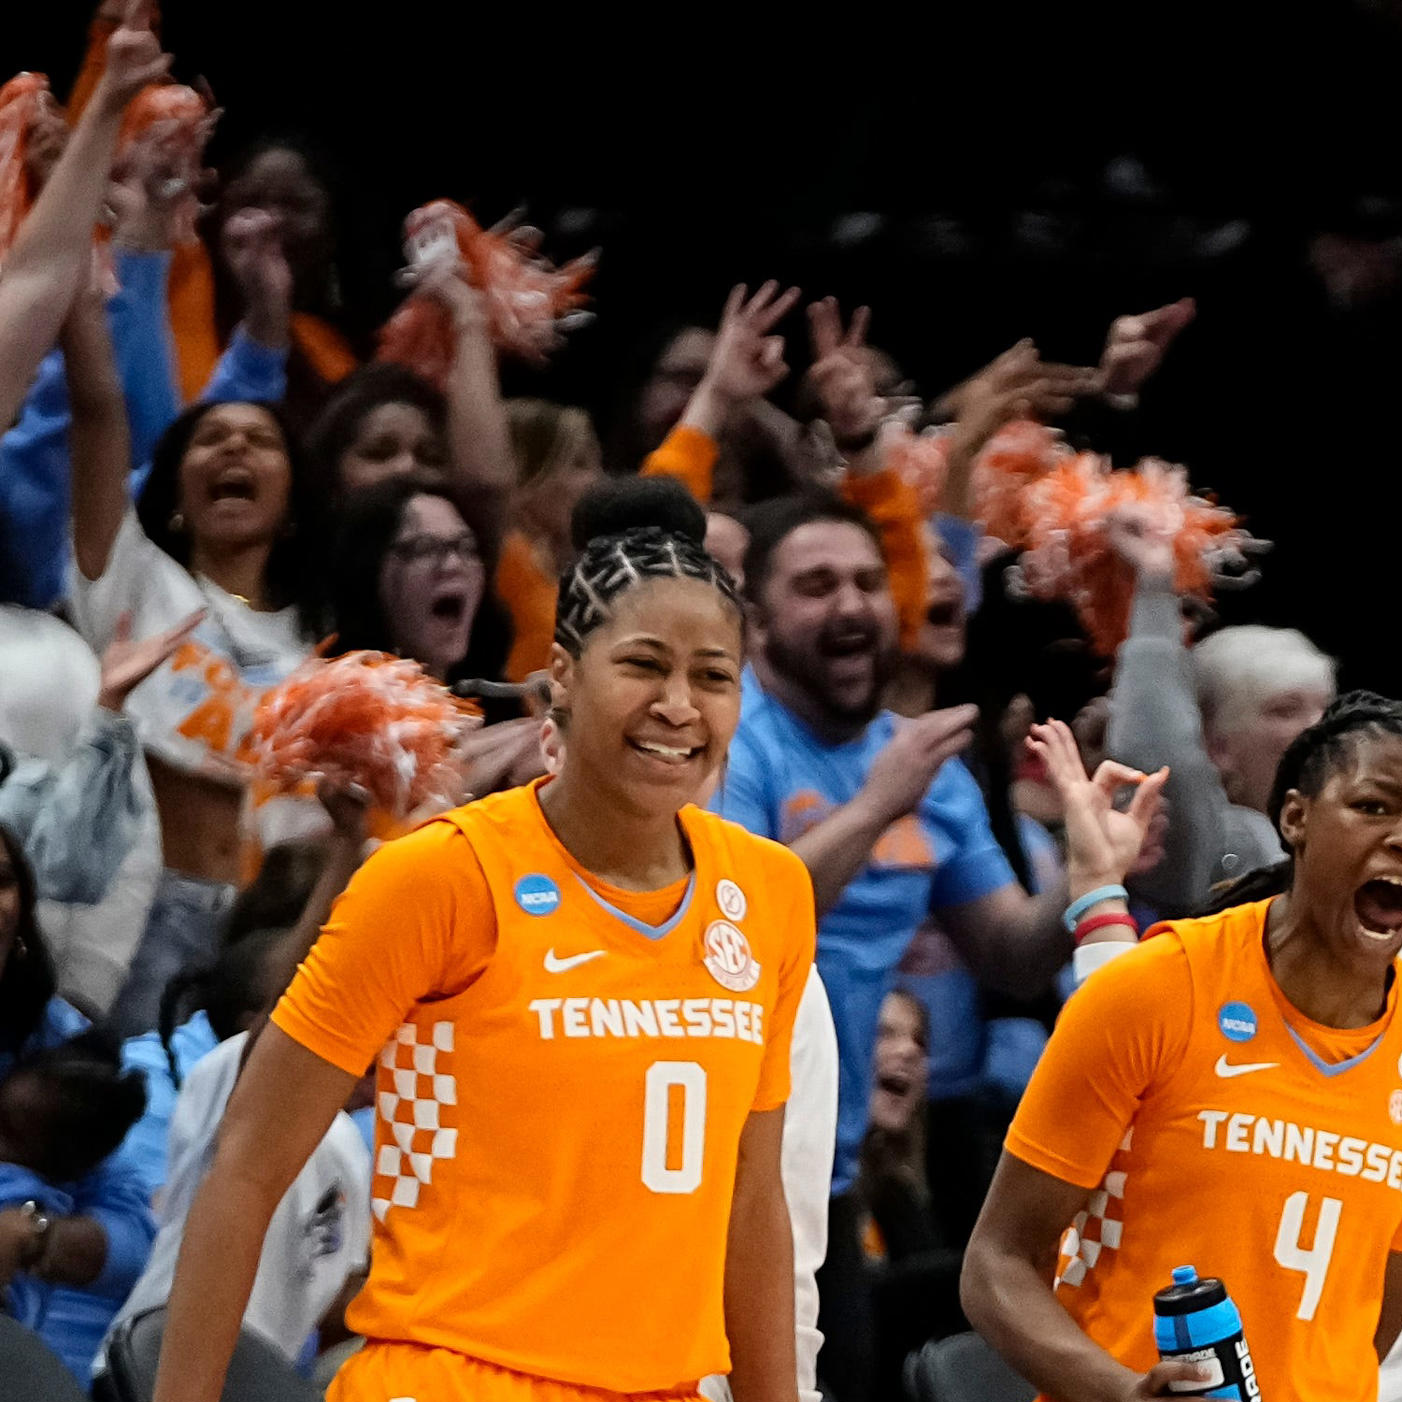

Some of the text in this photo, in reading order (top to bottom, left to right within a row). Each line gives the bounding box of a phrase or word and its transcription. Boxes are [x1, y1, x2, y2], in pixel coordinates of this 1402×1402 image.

[528, 997, 764, 1045] TENNESSEE
[641, 1060, 707, 1194] 0
[1273, 1190, 1343, 1321] 4
